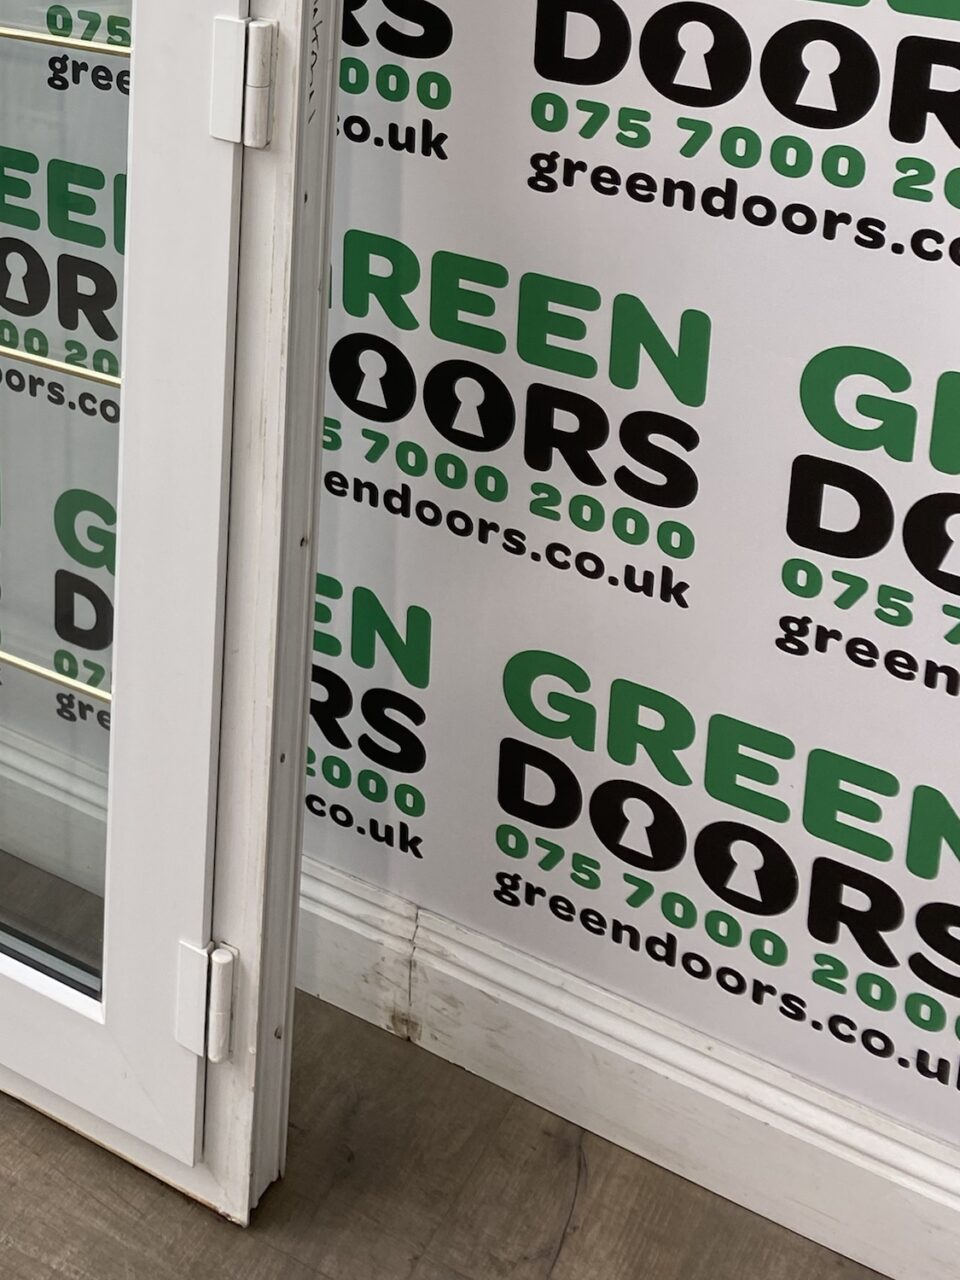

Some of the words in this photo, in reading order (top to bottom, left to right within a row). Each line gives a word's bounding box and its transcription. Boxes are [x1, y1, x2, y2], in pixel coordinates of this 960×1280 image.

[531, 92, 651, 148] 075
[677, 117, 865, 188] 7000
[329, 332, 700, 508] OORS
[324, 471, 689, 608] endoors.co.uk
[361, 428, 508, 502] 7000
[529, 482, 694, 559] 2000
[782, 559, 913, 626] 075
[496, 824, 601, 889] 075
[624, 873, 788, 966] 7000
